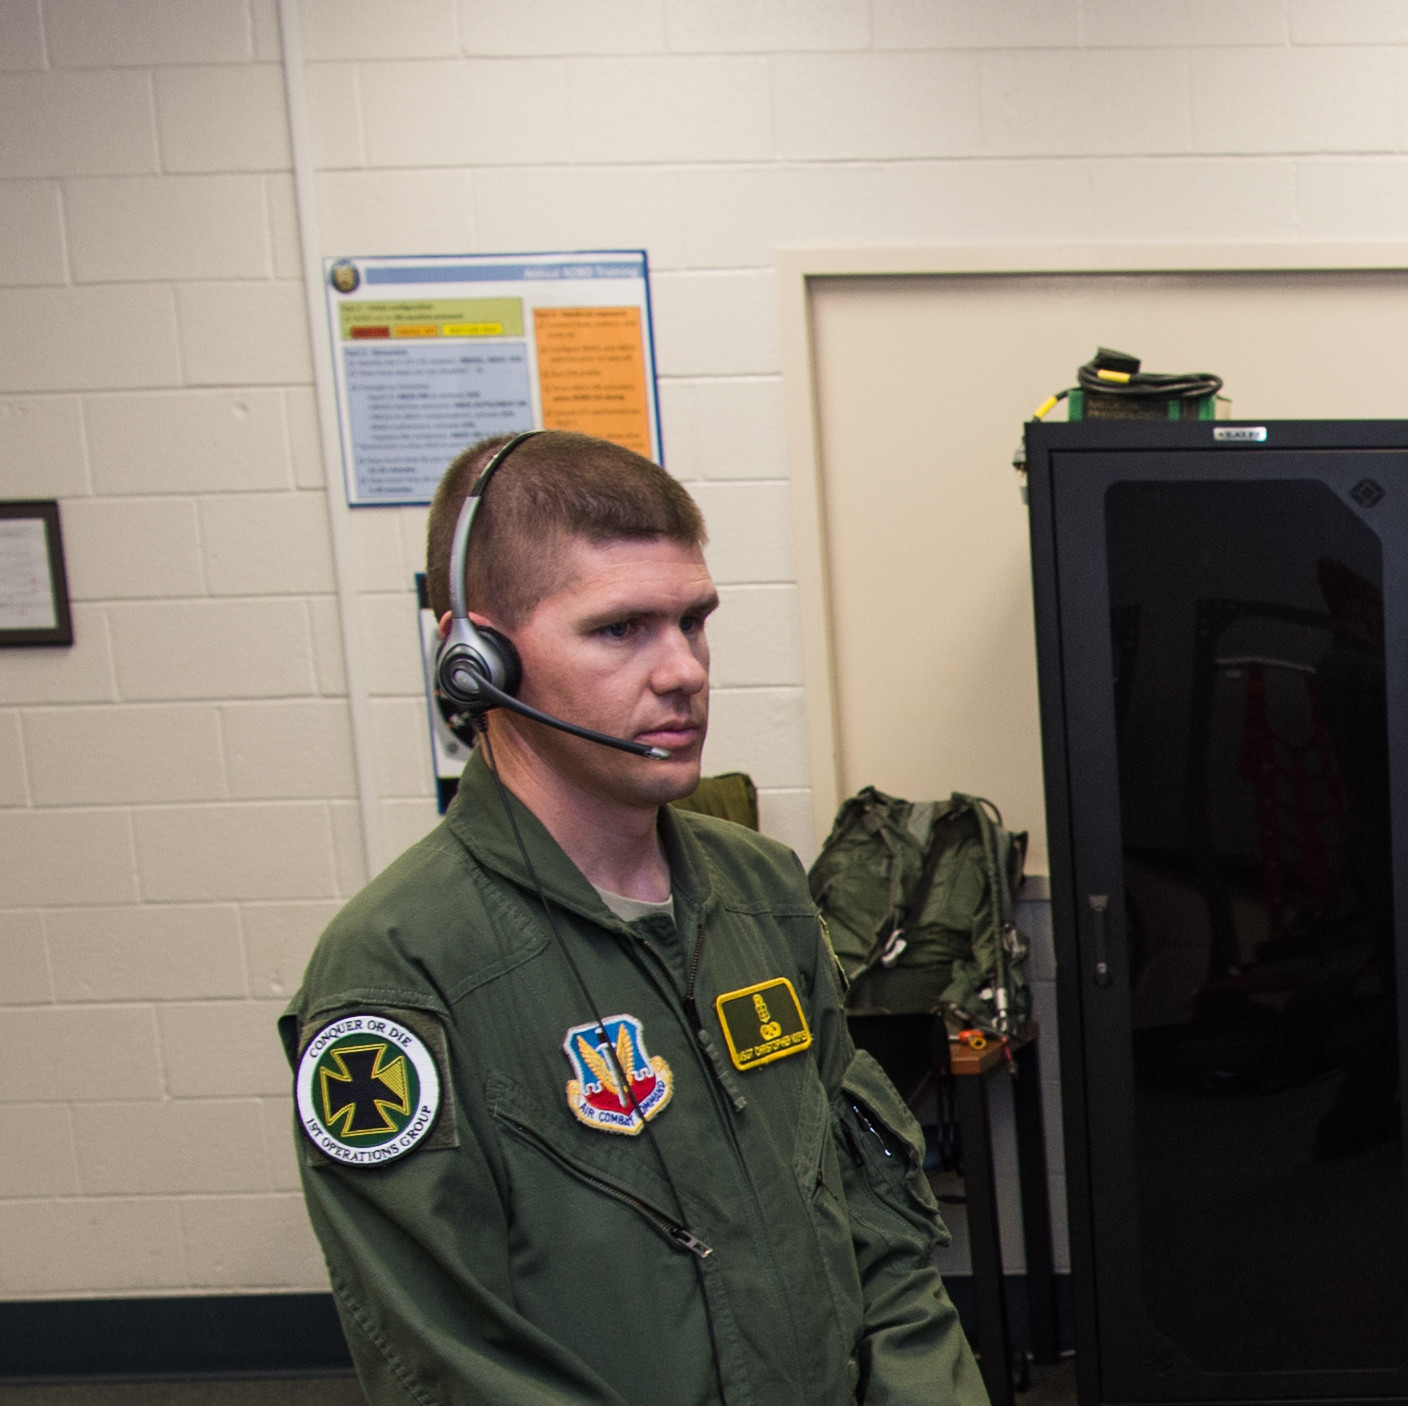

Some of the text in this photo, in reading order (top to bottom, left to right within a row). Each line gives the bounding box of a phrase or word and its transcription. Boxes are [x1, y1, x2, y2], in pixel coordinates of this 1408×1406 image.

[309, 1020, 412, 1058] CONQUER OR DIE
[306, 1105, 431, 1161] 1ST OPERATIONS GROUP
[580, 1103, 594, 1118] AIR
[599, 1112, 634, 1126] COMBAT
